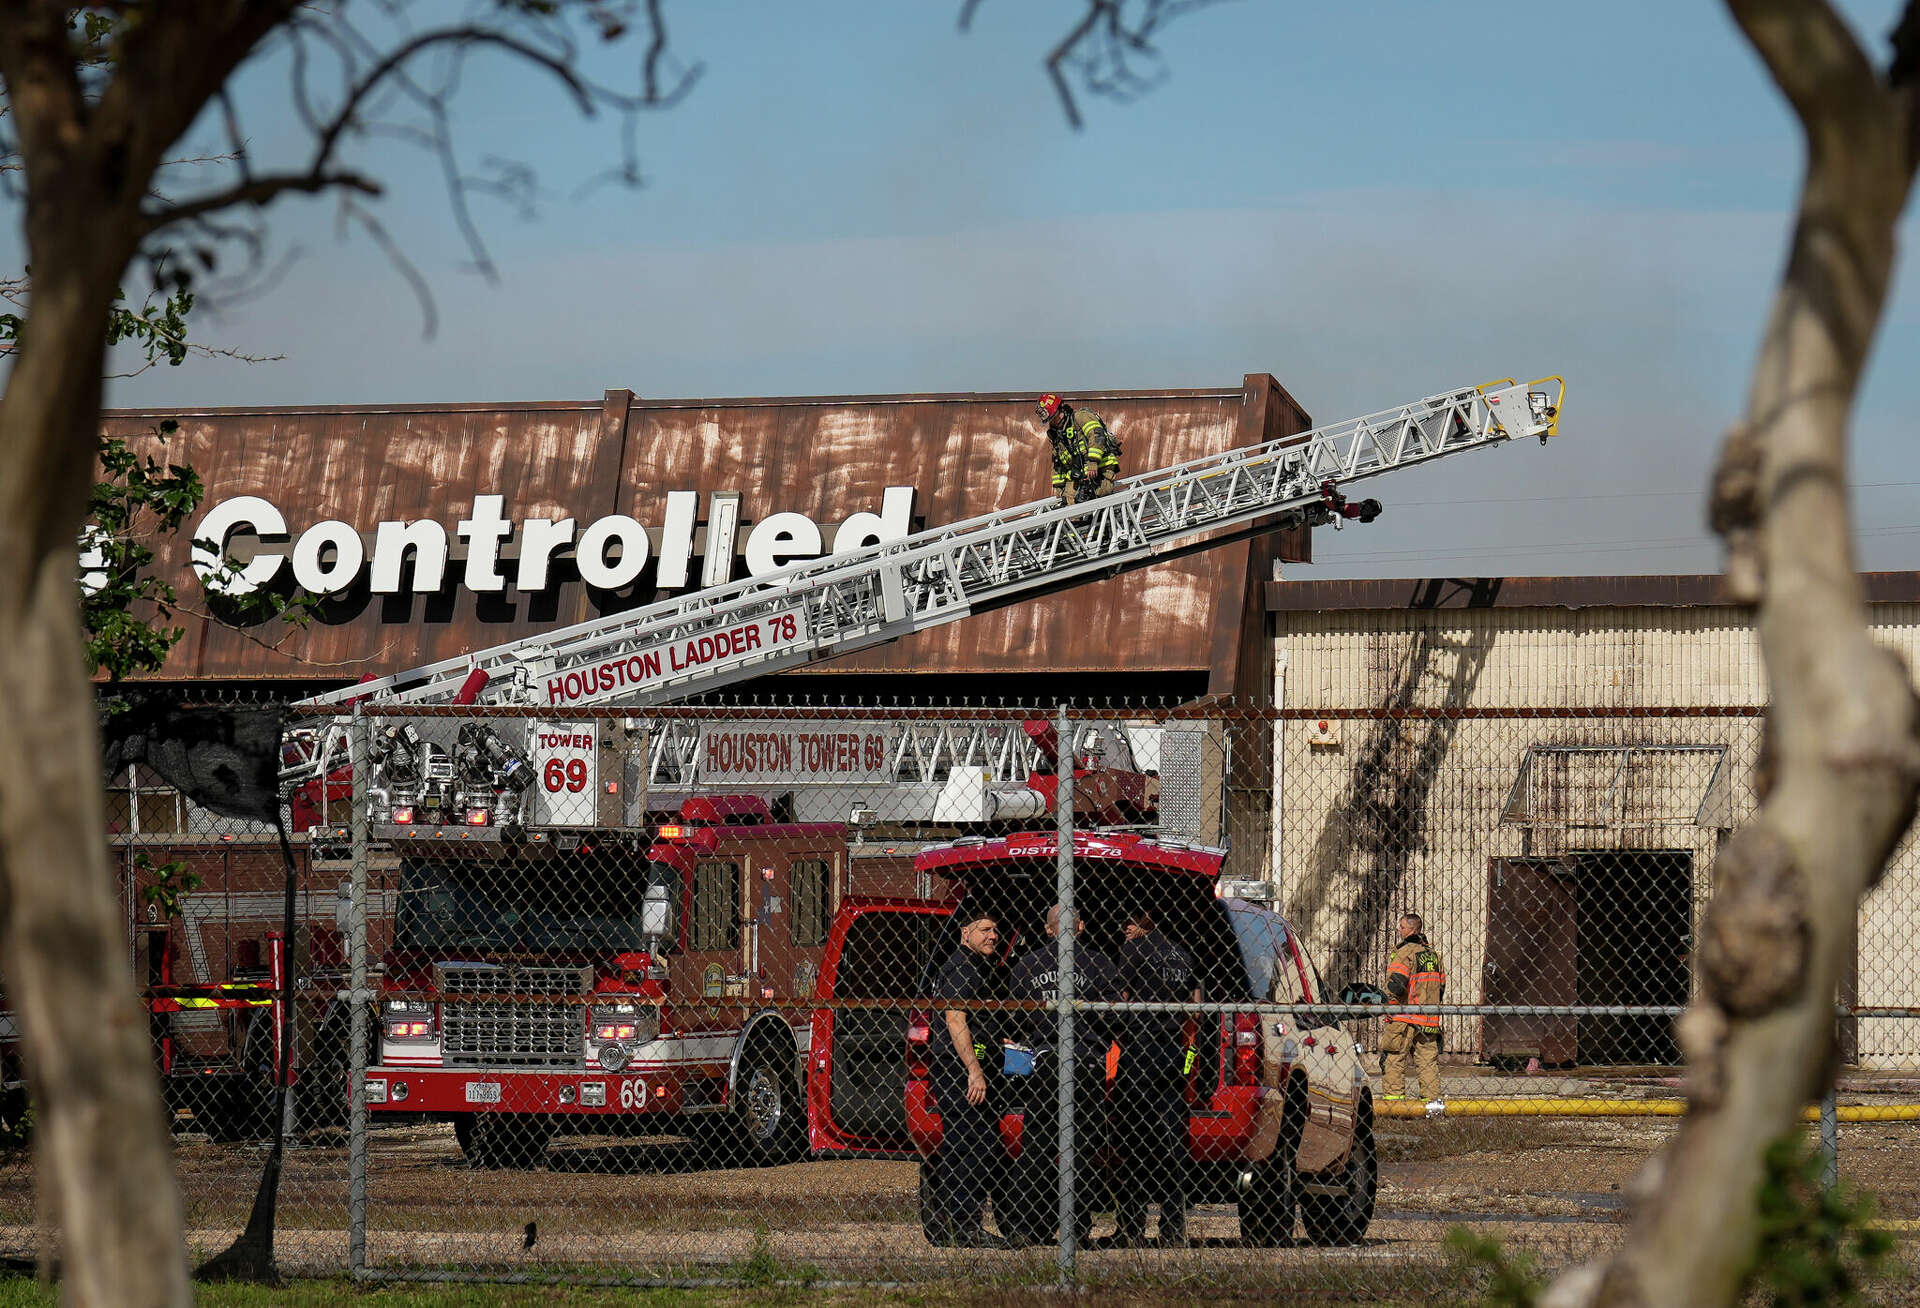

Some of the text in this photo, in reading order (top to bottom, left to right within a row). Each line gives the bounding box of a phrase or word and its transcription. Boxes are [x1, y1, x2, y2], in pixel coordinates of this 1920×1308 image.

[190, 486, 914, 598] Controlled
[547, 613, 798, 705] HOUSTON LADDER 78
[538, 733, 593, 751] TOWER
[706, 732, 885, 773] HOUSTON TOWER 69
[543, 757, 588, 793] 69
[1008, 846, 1123, 857] DISTRCT 78
[620, 1078, 647, 1109] 69
